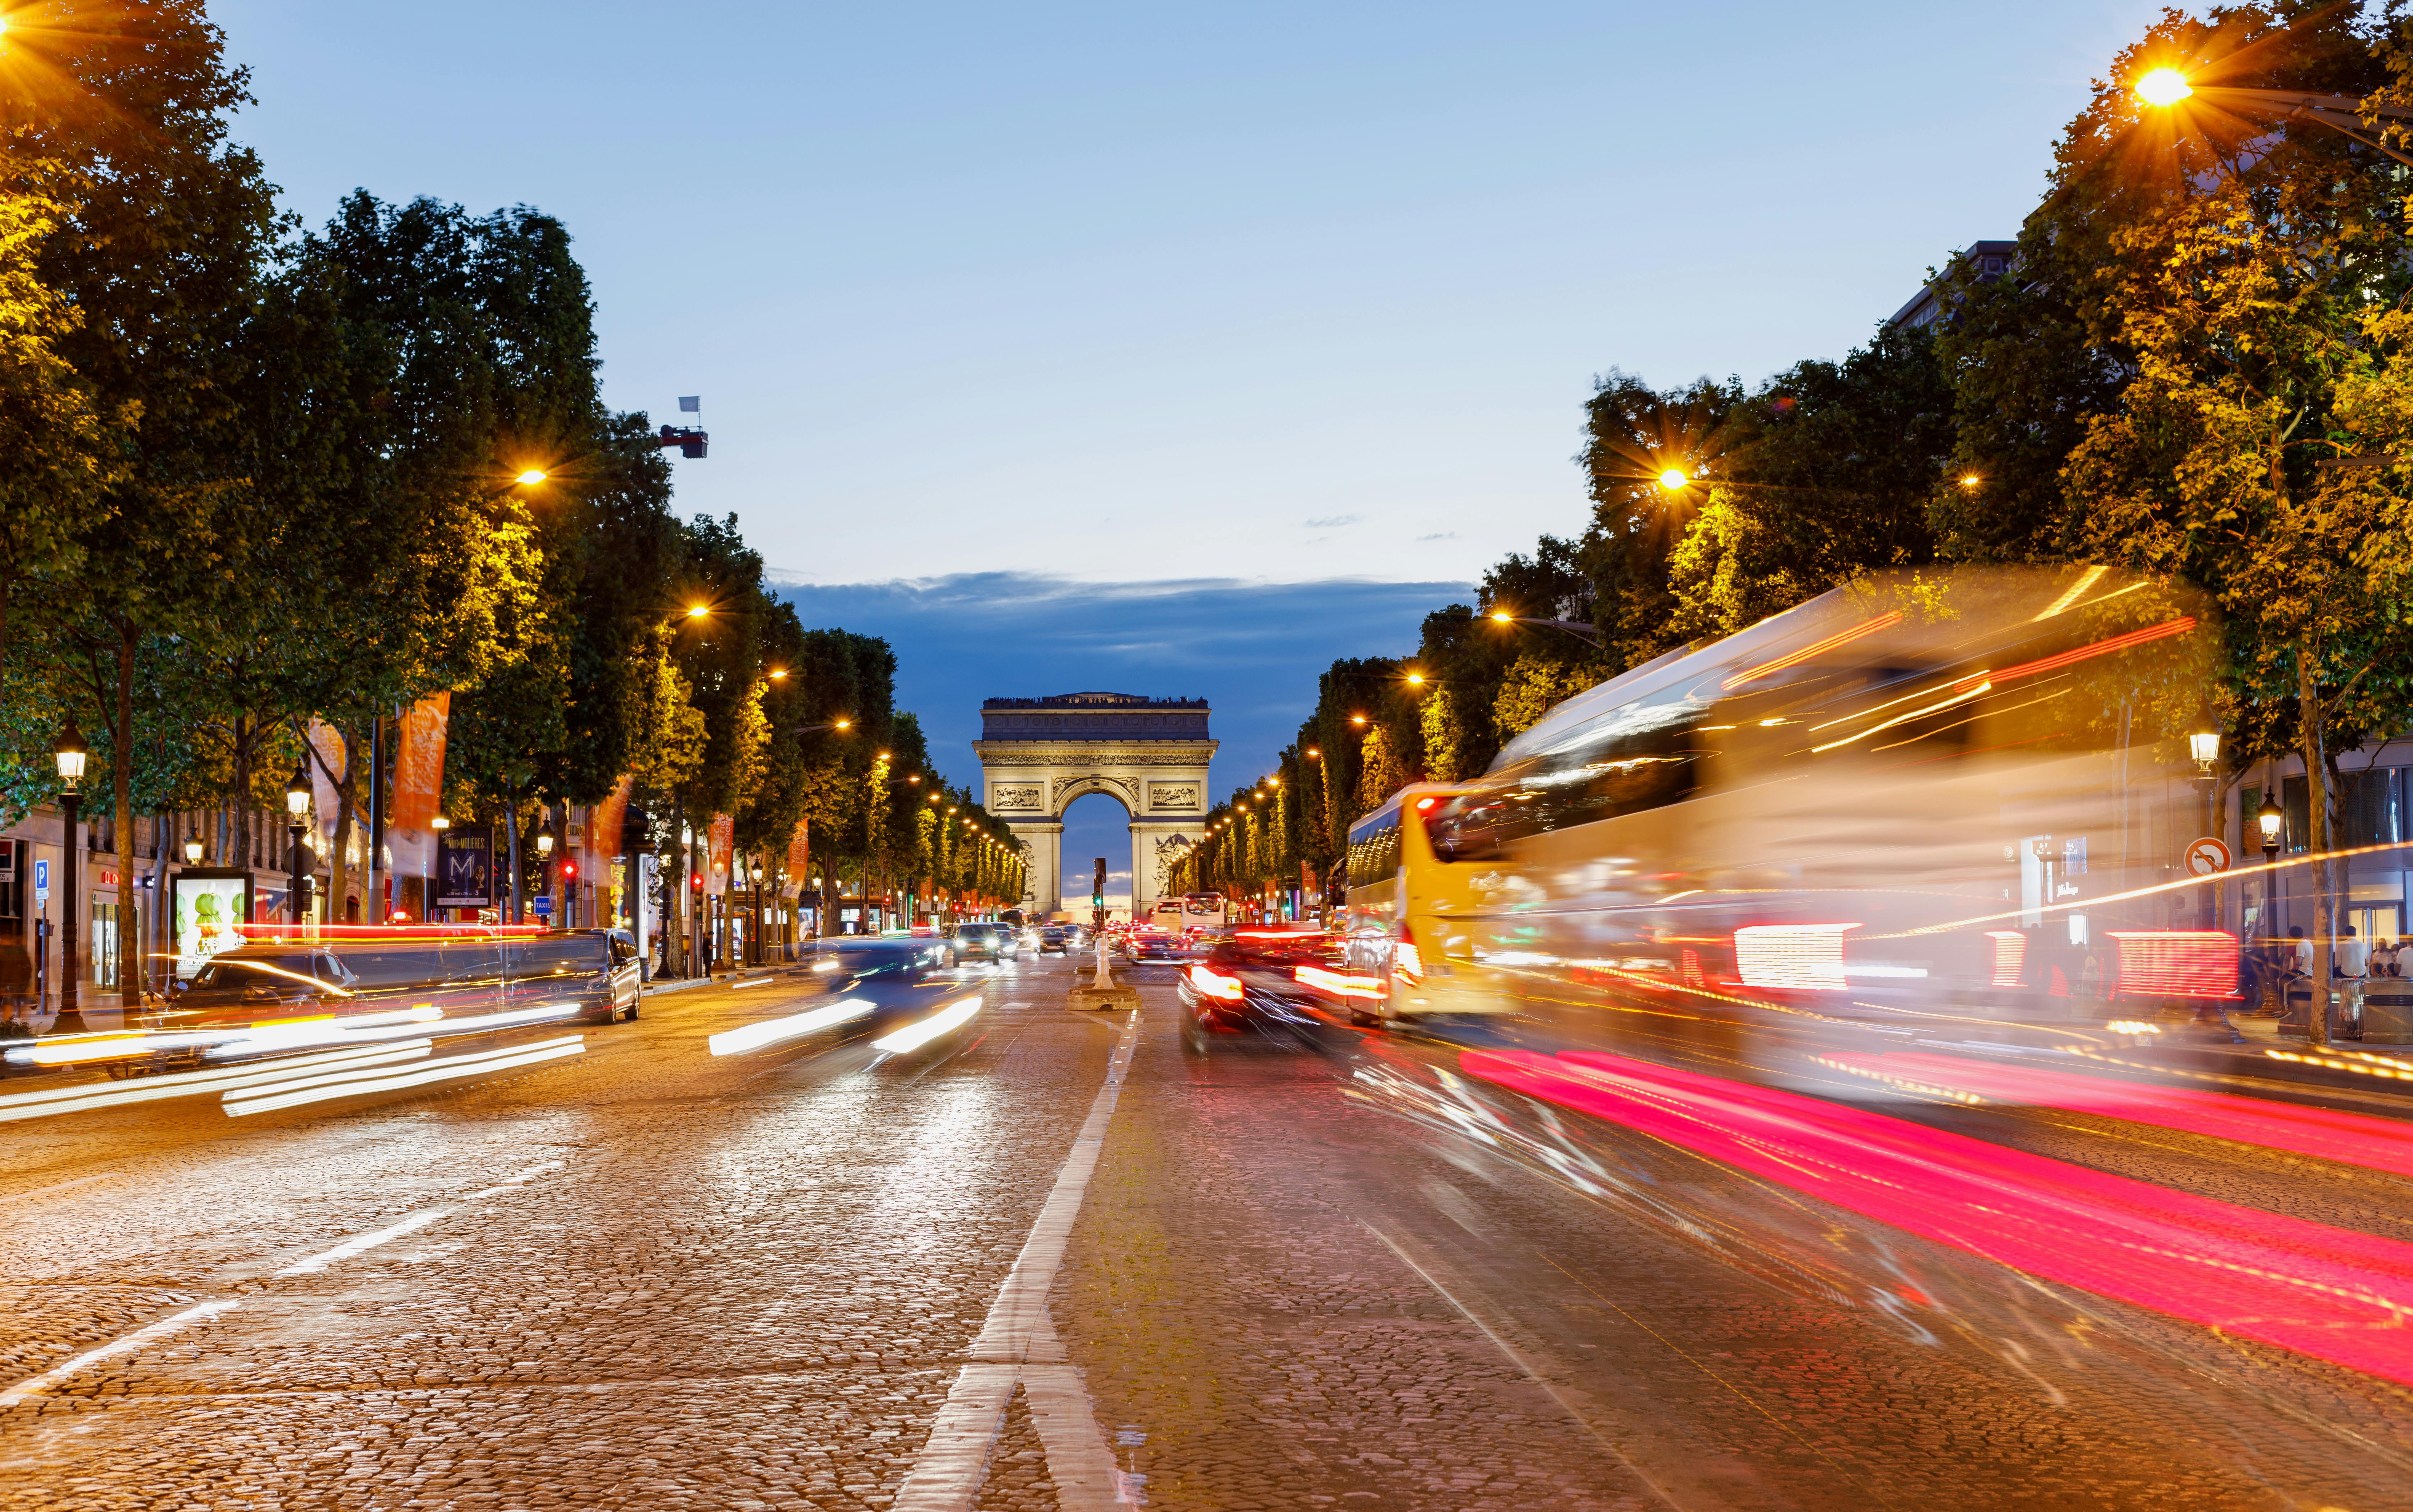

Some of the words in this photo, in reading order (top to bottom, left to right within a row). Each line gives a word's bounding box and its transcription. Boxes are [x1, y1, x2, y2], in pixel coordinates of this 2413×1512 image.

[448, 839, 459, 849] NUIT
[461, 836, 484, 849] MOLIÈRES
[39, 867, 45, 884] P
